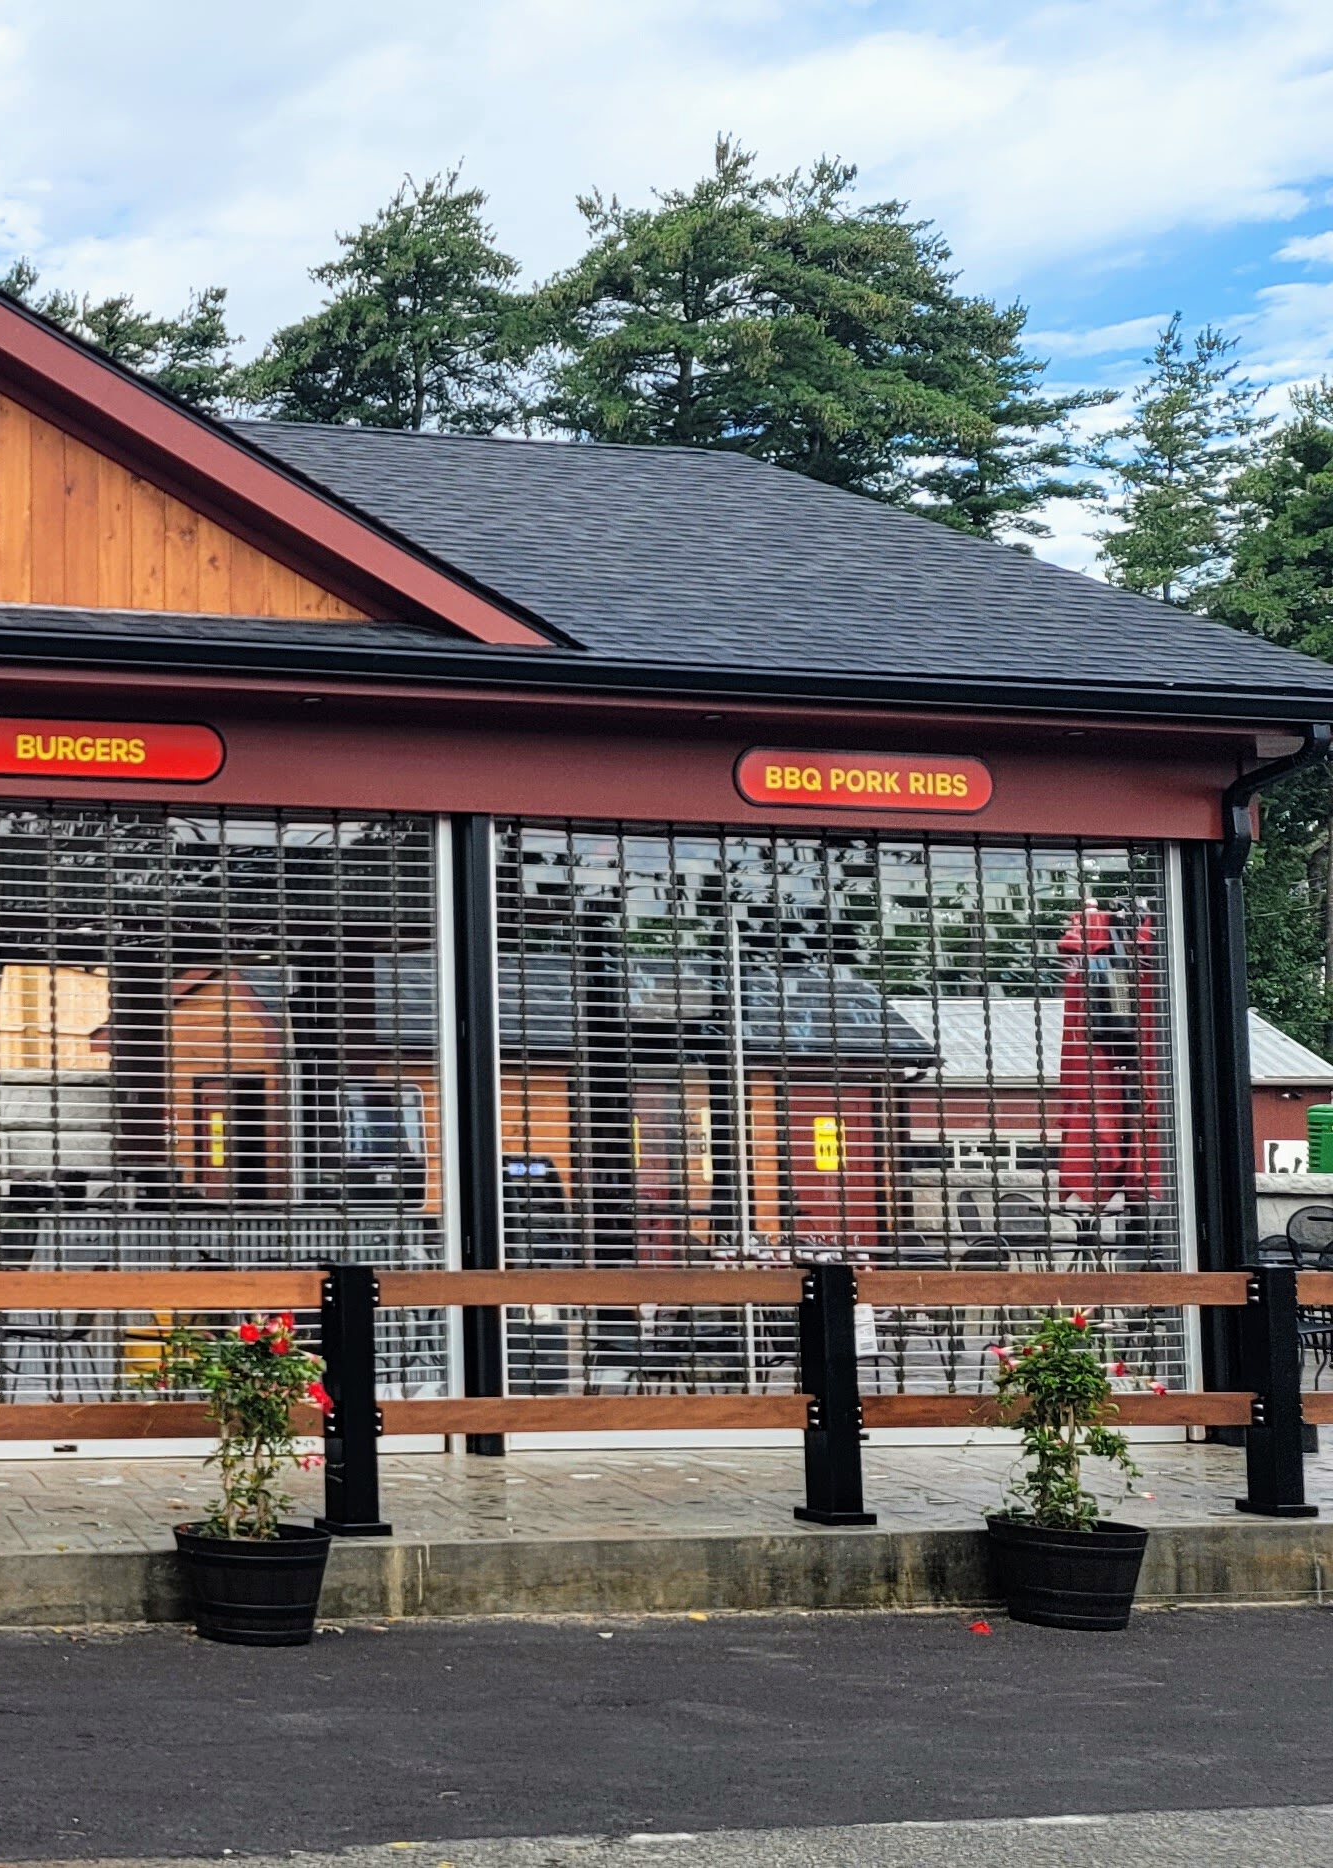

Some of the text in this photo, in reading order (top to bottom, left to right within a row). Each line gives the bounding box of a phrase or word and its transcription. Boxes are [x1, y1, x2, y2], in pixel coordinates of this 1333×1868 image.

[16, 734, 146, 764] BURGERS
[765, 765, 969, 797] BBQ PORK RIBS
